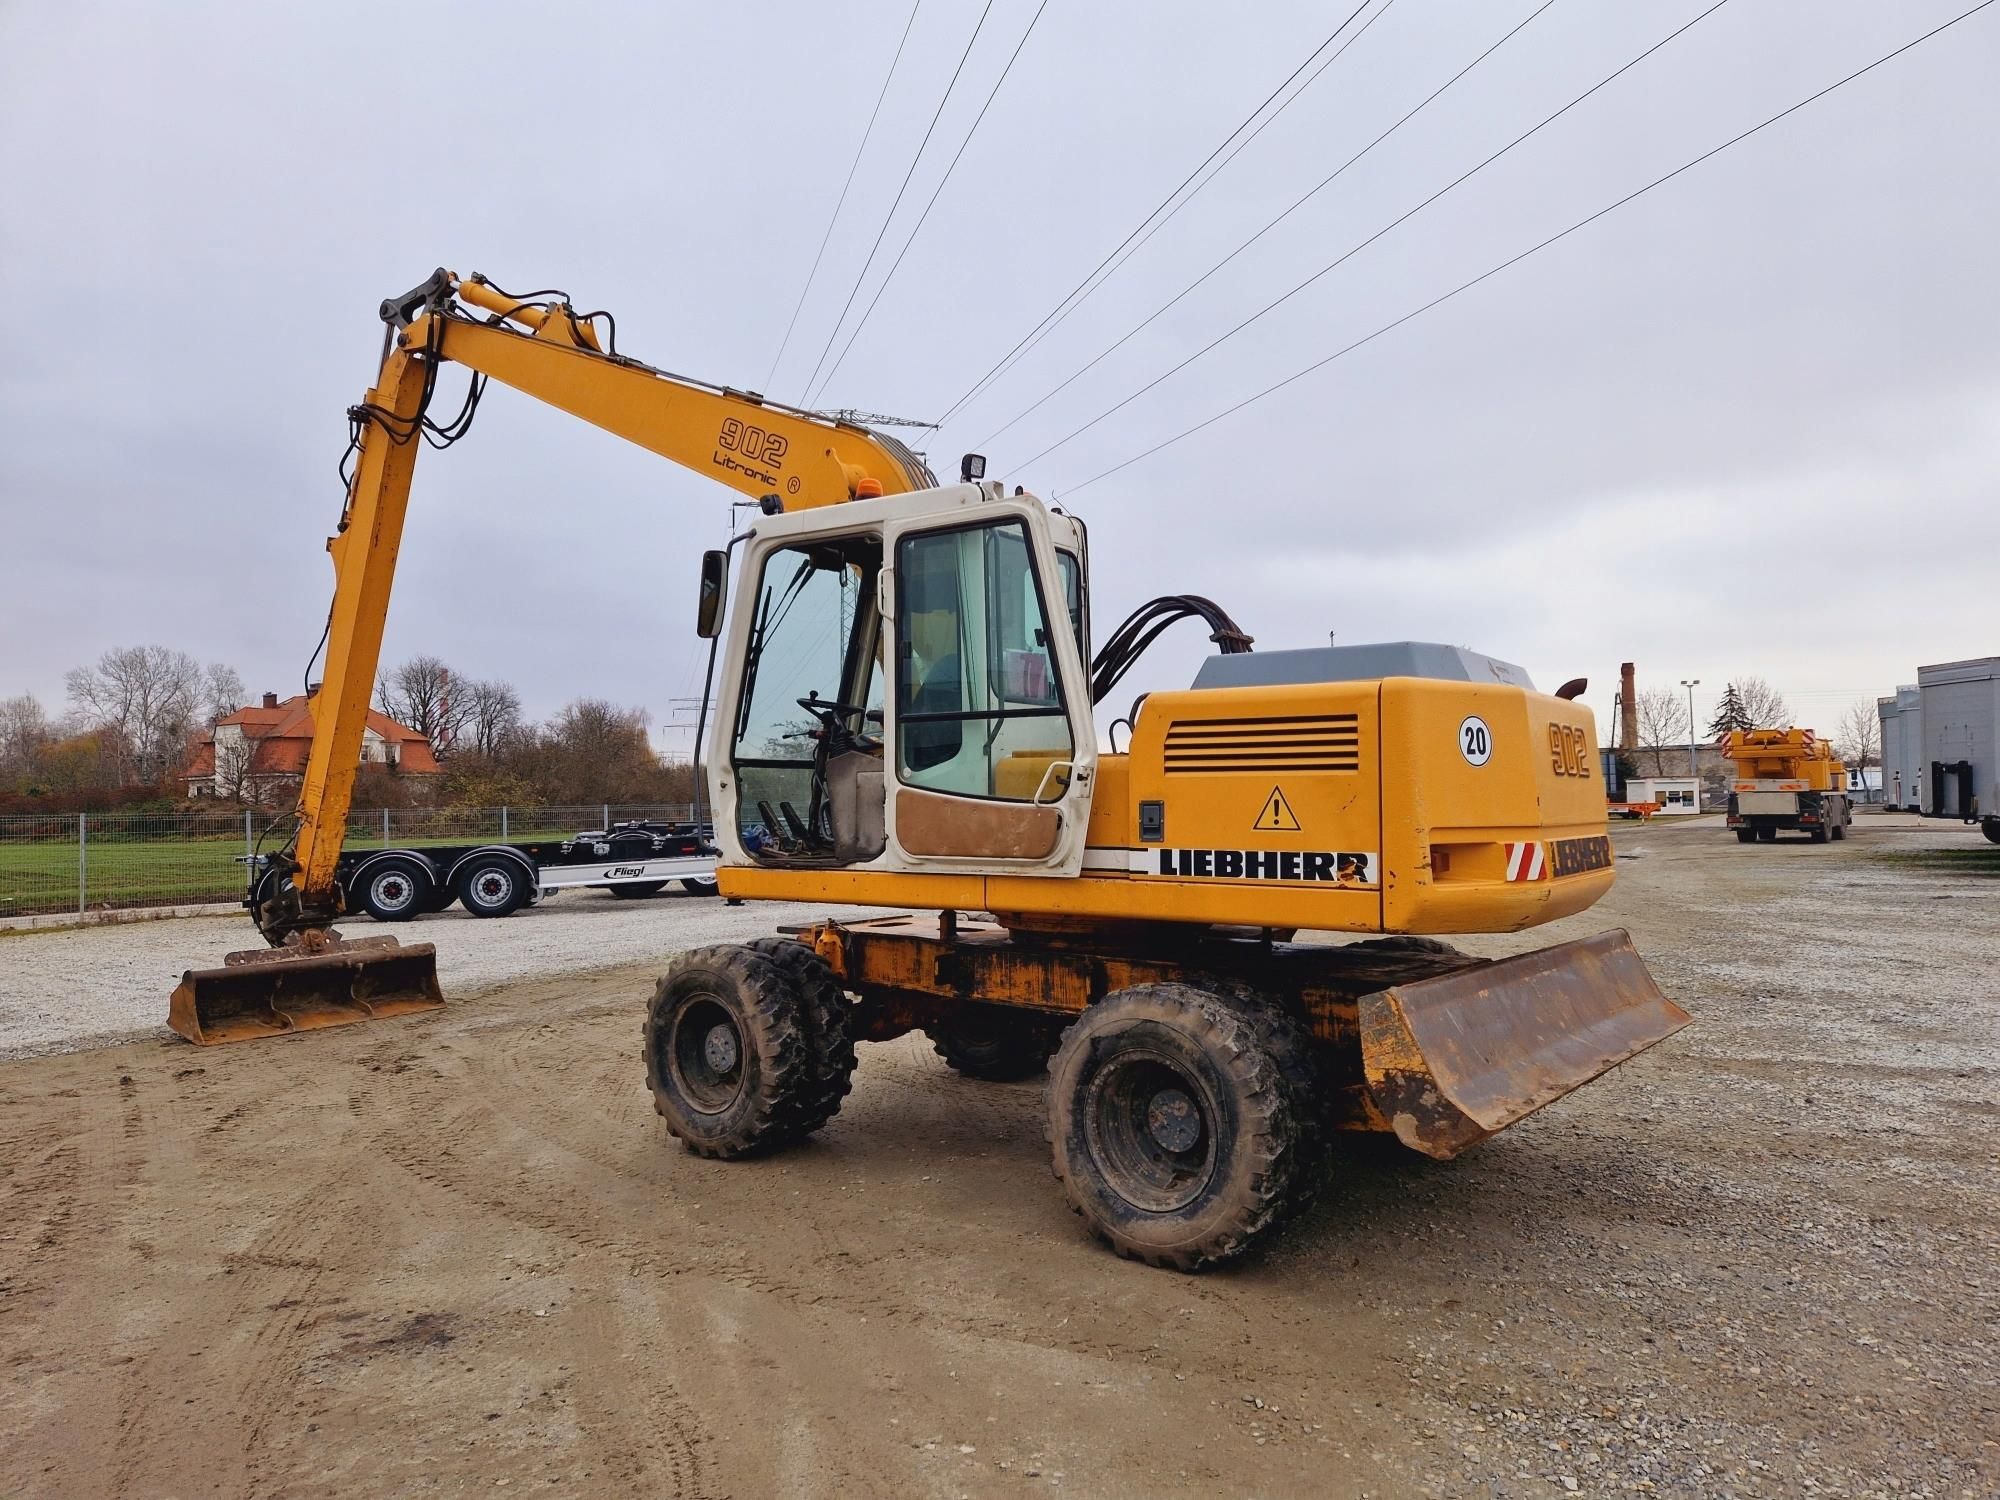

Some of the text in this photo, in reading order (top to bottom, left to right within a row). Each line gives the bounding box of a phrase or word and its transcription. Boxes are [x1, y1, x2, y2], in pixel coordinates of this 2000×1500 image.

[719, 417, 788, 469] 902
[713, 450, 777, 486] Litronic
[1465, 726, 1486, 755] 20
[1549, 722, 1590, 778] 902
[613, 866, 645, 877] Fliegl
[1160, 849, 1368, 882] LIEBHERR
